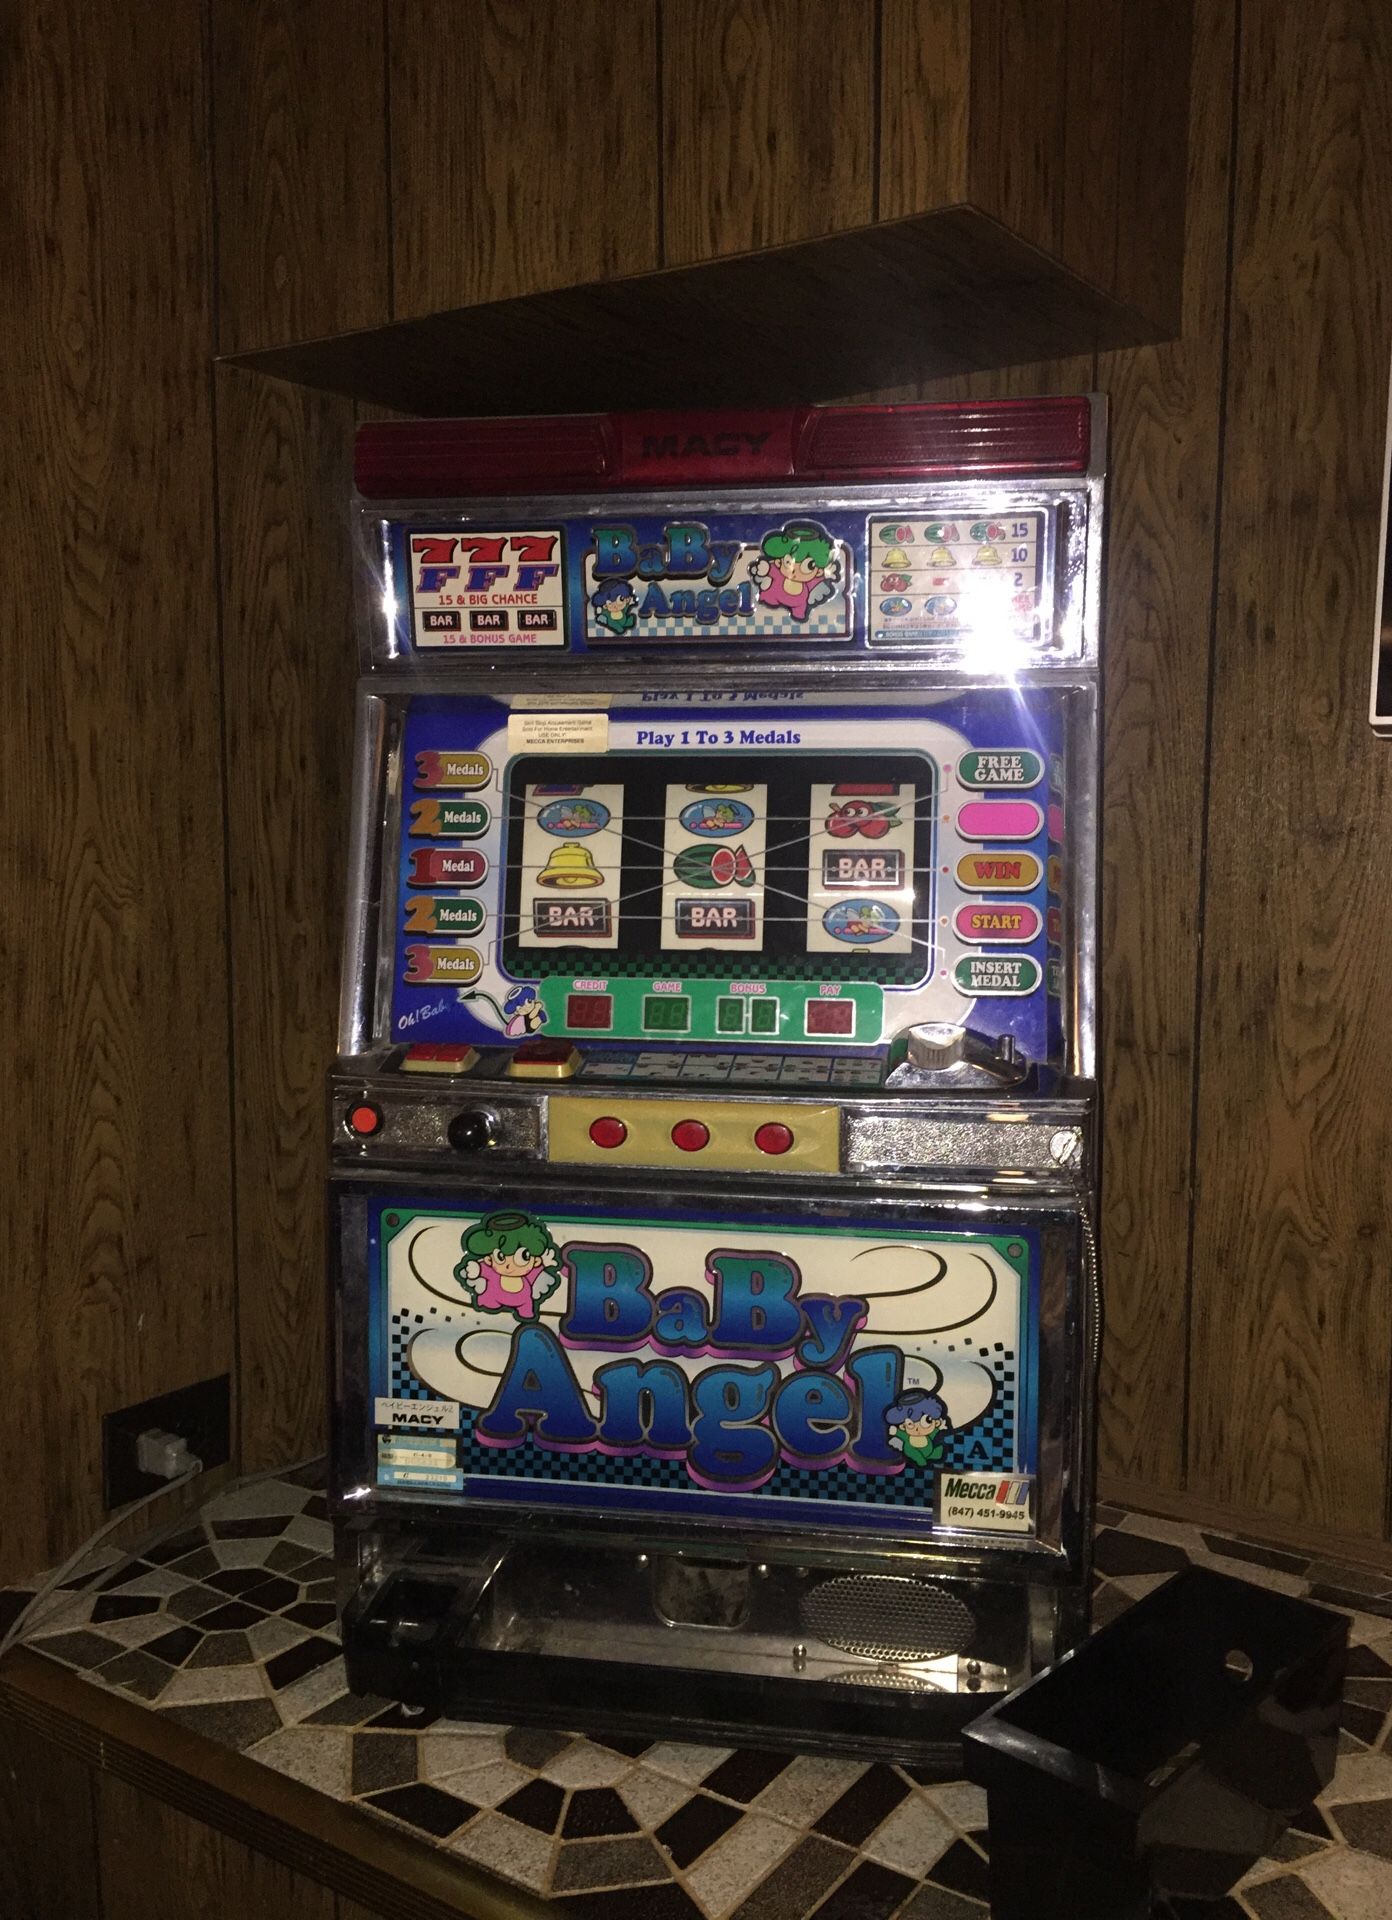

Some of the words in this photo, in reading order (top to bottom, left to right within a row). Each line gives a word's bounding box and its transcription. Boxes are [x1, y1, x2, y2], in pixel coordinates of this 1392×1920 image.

[642, 431, 773, 459] MACY
[1011, 522, 1028, 538] 15
[1011, 547, 1028, 562] 10
[1014, 573, 1023, 587] 2
[438, 595, 453, 605] 15
[469, 594, 488, 605] BIG
[491, 593, 538, 605] CHANCE
[638, 581, 755, 625] Angel
[430, 615, 453, 626] BAR
[477, 614, 501, 626] BAR
[525, 614, 549, 625] BAR
[443, 635, 456, 644] 15
[470, 634, 505, 644] BONUS
[509, 633, 537, 643] GAME
[637, 731, 675, 747] Play
[680, 731, 690, 744] 1
[696, 730, 719, 744] To
[723, 730, 734, 744] 3
[739, 730, 801, 744] Medals
[413, 751, 444, 787] 3
[447, 763, 484, 776] Medals
[977, 755, 1022, 769] FREE
[974, 768, 1024, 782] GAME
[410, 798, 442, 835] 2
[444, 811, 482, 824] Medals
[408, 848, 437, 883] 1
[442, 859, 475, 872] Medal
[838, 857, 887, 879] BAR
[974, 861, 1021, 880] WIN
[405, 895, 437, 932] 2
[439, 909, 477, 922] Medals
[548, 906, 595, 928] BAR
[690, 907, 739, 929] BAR
[971, 914, 1022, 930] START
[403, 944, 434, 981] 3
[437, 957, 475, 970] Medals
[970, 961, 1022, 975] INSERT
[572, 979, 609, 991] CREDIT
[652, 981, 682, 993] GAME
[730, 982, 767, 995] BONUS
[970, 974, 1021, 988] MEDAL
[819, 984, 842, 996] PAY
[477, 1323, 905, 1490] Angel
[392, 1413, 444, 1425] MACY
[944, 1478, 997, 1500] Mecca
[948, 1506, 974, 1518] (847)
[977, 1508, 1025, 1520] 451-9945
